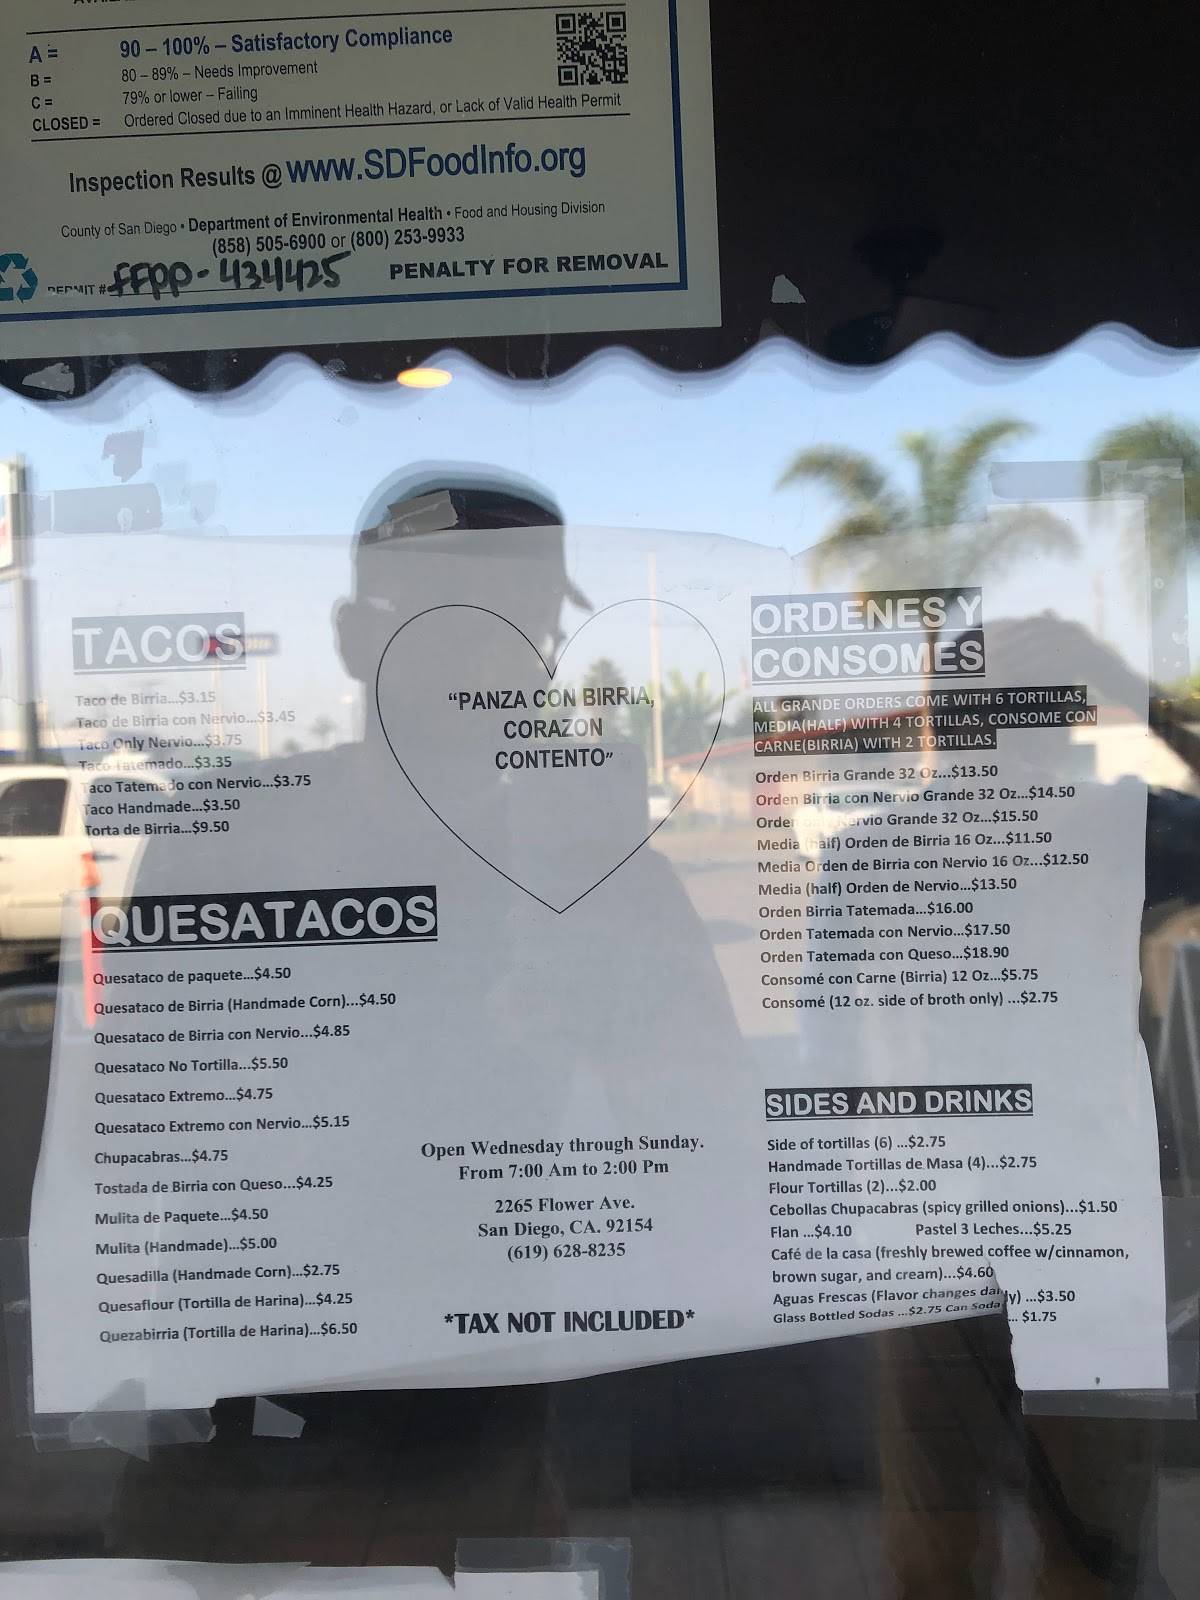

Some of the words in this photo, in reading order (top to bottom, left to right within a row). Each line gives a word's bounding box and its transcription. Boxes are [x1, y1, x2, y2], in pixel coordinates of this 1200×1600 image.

[120, 40, 140, 58] 90
[163, 35, 209, 56] 100%
[232, 32, 339, 53] Satisfactory
[346, 26, 452, 50] Compliance
[122, 68, 136, 83] 80
[152, 66, 178, 81] 89%
[195, 65, 233, 79] Needs
[239, 60, 317, 79] Improvement
[123, 90, 149, 105] 79%
[154, 93, 166, 104] or
[170, 88, 202, 103] lower
[218, 85, 257, 103] Failing
[125, 112, 173, 127] Ordered
[178, 111, 219, 125] Closed
[224, 109, 246, 123] due
[251, 109, 261, 122] to
[266, 110, 280, 121] an
[286, 104, 341, 121] Imminent
[345, 102, 383, 118] Health
[440, 102, 452, 113] or
[456, 98, 484, 113] Lack
[489, 97, 500, 111] of
[504, 96, 533, 111] Valid
[539, 95, 577, 109] Health
[582, 93, 621, 107] Permit
[33, 116, 88, 132] CLOSED
[70, 169, 173, 196] Inspection
[181, 165, 255, 188] Results
[286, 143, 587, 183] www.SDFoodInfo.org
[62, 224, 100, 239] County
[105, 222, 114, 235] of
[119, 223, 140, 235] San
[145, 221, 176, 237] Diego
[189, 215, 269, 235] Department
[274, 212, 287, 228] of
[292, 207, 393, 227] Environmental
[398, 205, 442, 222] Health
[455, 205, 482, 219] Food
[487, 205, 507, 218] and
[512, 202, 557, 218] Housing
[562, 200, 605, 215] Division
[256, 233, 326, 252] 505-6900
[331, 235, 346, 249] or
[395, 226, 464, 246] 253-9933
[390, 259, 495, 280] PENALTY
[504, 257, 549, 275] FOR
[557, 252, 668, 272] REMOVAL
[752, 596, 947, 635] ORDENES
[957, 595, 982, 627] Y
[73, 623, 243, 666] TACOS
[753, 641, 983, 679] CONSOMES
[533, 689, 576, 708] CON
[754, 699, 778, 713] ALL
[781, 698, 841, 712] GRANDE
[845, 696, 902, 710] ORDERS
[906, 695, 948, 708] COME
[953, 692, 992, 706] WITH
[503, 718, 602, 739] CORAZON
[863, 737, 902, 751] WITH
[85, 824, 120, 837] Torta
[123, 824, 140, 836] de
[93, 895, 436, 947] QUESATACOS
[760, 928, 801, 940] Orden
[807, 926, 874, 940] Tatemada
[879, 929, 902, 938] con
[93, 973, 163, 986] Quesataco
[168, 970, 184, 983] de
[762, 972, 824, 986] Consomé
[829, 975, 852, 985] con
[857, 972, 896, 984] Carne
[952, 970, 967, 982] 12
[94, 1002, 164, 1015] Quesataco
[168, 1000, 184, 1012] de
[189, 999, 223, 1012] Birria
[765, 1092, 849, 1117] SIDES
[857, 1091, 917, 1115] AND
[925, 1088, 1032, 1114] DRINKS
[422, 1143, 464, 1161] Open
[472, 1139, 563, 1156] Wednesday
[570, 1136, 633, 1155] through
[768, 1139, 796, 1151] Side
[801, 1137, 814, 1149] of
[818, 1136, 869, 1150] tortillas
[460, 1165, 502, 1180] From
[509, 1164, 542, 1179] 7:00
[550, 1163, 576, 1177] Am
[583, 1163, 597, 1176] to
[604, 1159, 637, 1175] 2:00
[644, 1160, 668, 1174] Pm
[769, 1159, 842, 1172] Handmade
[846, 1157, 901, 1171] Tortillas
[906, 1158, 922, 1170] de
[927, 1157, 962, 1169] Masa
[95, 1181, 147, 1195] Tostada
[152, 1180, 168, 1193] de
[173, 1180, 207, 1193] Birria
[213, 1182, 235, 1192] con
[496, 1198, 532, 1213] 2265
[539, 1198, 594, 1212] Flower
[479, 1224, 508, 1237] San
[607, 1218, 652, 1233] 92154
[554, 1242, 625, 1259] 628-8235
[772, 1248, 801, 1261] Café
[806, 1248, 822, 1260] de
[827, 1247, 838, 1259] la
[843, 1249, 871, 1259] casa
[932, 1244, 983, 1257] brewed
[988, 1246, 1031, 1259] coffee
[97, 1269, 168, 1285] Quesadilla
[508, 1311, 556, 1334] NOT
[100, 1327, 179, 1344] Quezabirria
[240, 1325, 255, 1337] de
